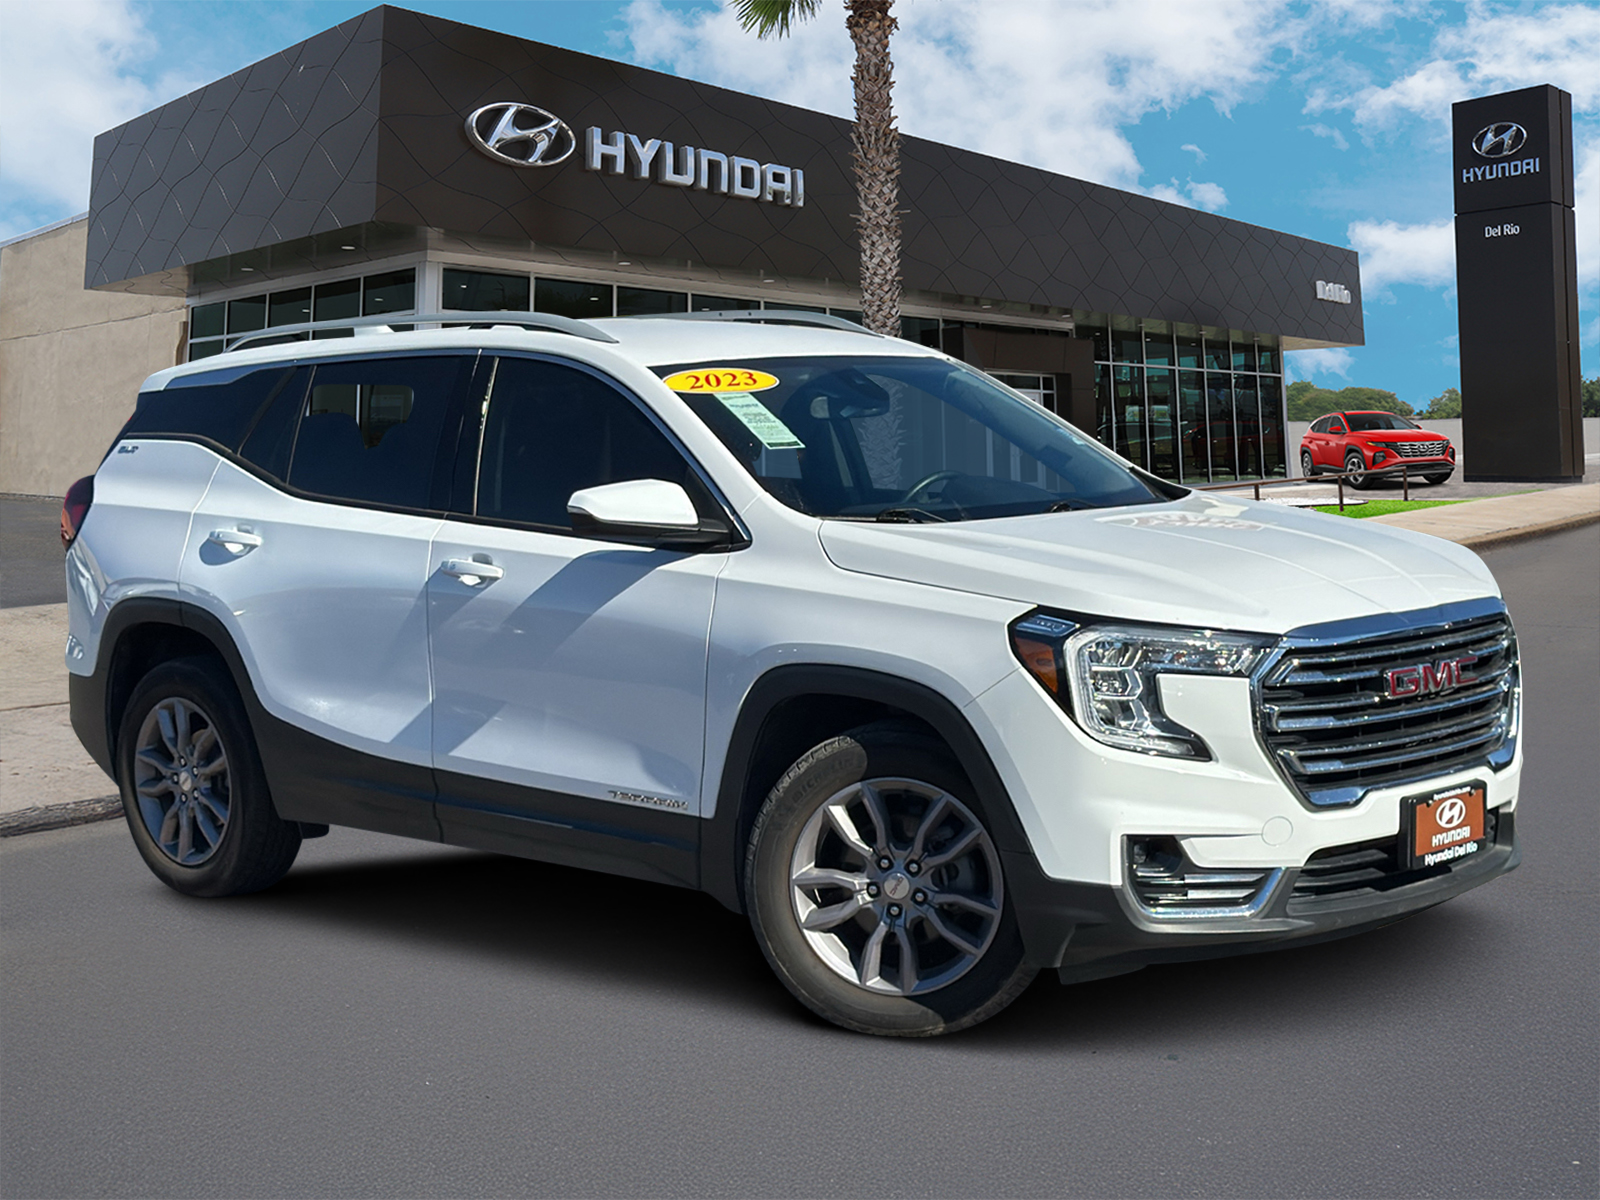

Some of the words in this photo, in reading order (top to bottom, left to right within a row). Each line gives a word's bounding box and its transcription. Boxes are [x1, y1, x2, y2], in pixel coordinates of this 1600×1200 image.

[585, 126, 804, 207] HYUNDAI
[1462, 157, 1540, 183] HYUNDAI
[1484, 225, 1501, 238] Del
[1503, 223, 1520, 236] Rio
[686, 371, 758, 390] 2023
[1385, 656, 1478, 698] GMC
[1431, 825, 1471, 848] HYUNDAI
[1424, 847, 1454, 867] Hyundai
[1454, 844, 1466, 858] Del
[1466, 841, 1478, 854] Rio
